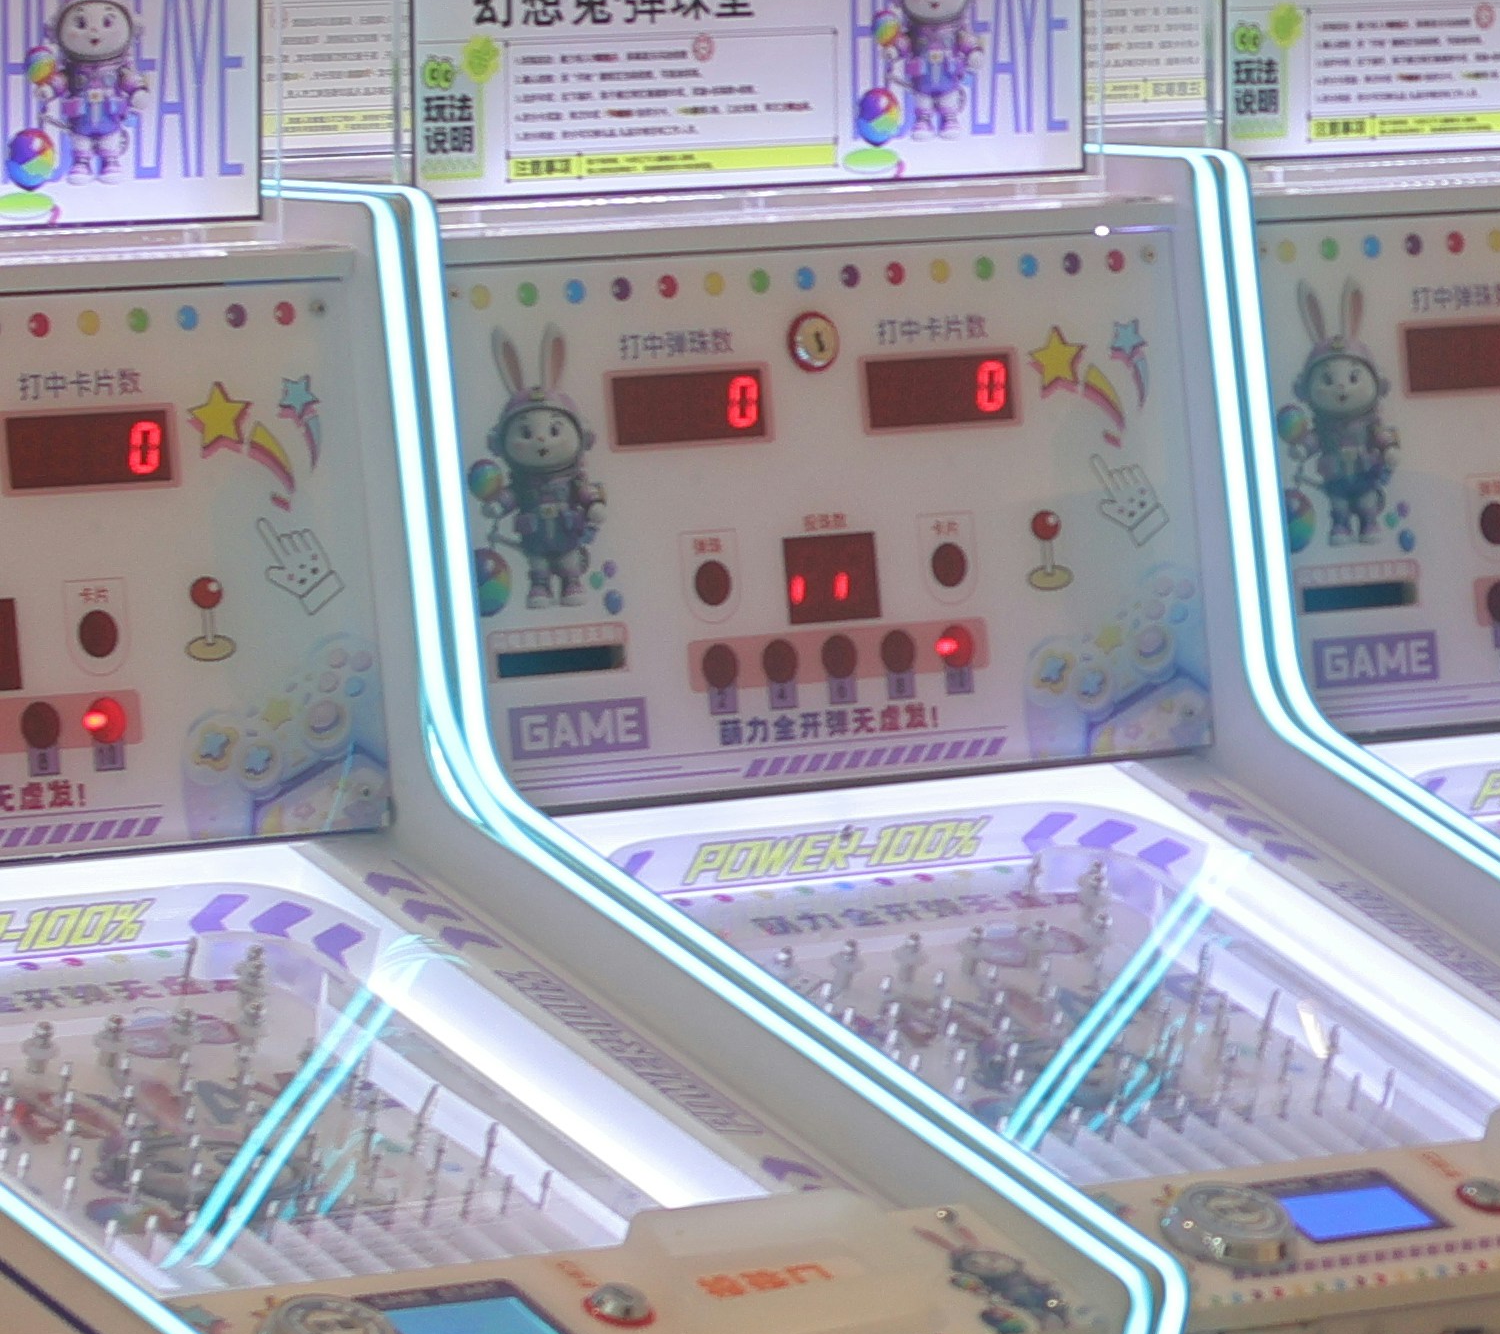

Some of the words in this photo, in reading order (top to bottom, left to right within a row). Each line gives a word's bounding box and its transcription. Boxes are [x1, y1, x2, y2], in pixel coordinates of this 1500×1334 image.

[619, 328, 735, 361] 打中弹珠数
[878, 314, 989, 345] 打中卡片数
[18, 368, 144, 402] 打中卡片数
[726, 374, 759, 429] 0
[975, 358, 1008, 412] 0
[127, 419, 162, 475] 0
[1323, 638, 1434, 681] GAME
[518, 700, 642, 752] GAME
[718, 702, 939, 747] 萌力全开弹无虚发!
[682, 815, 994, 886] POWER-100%
